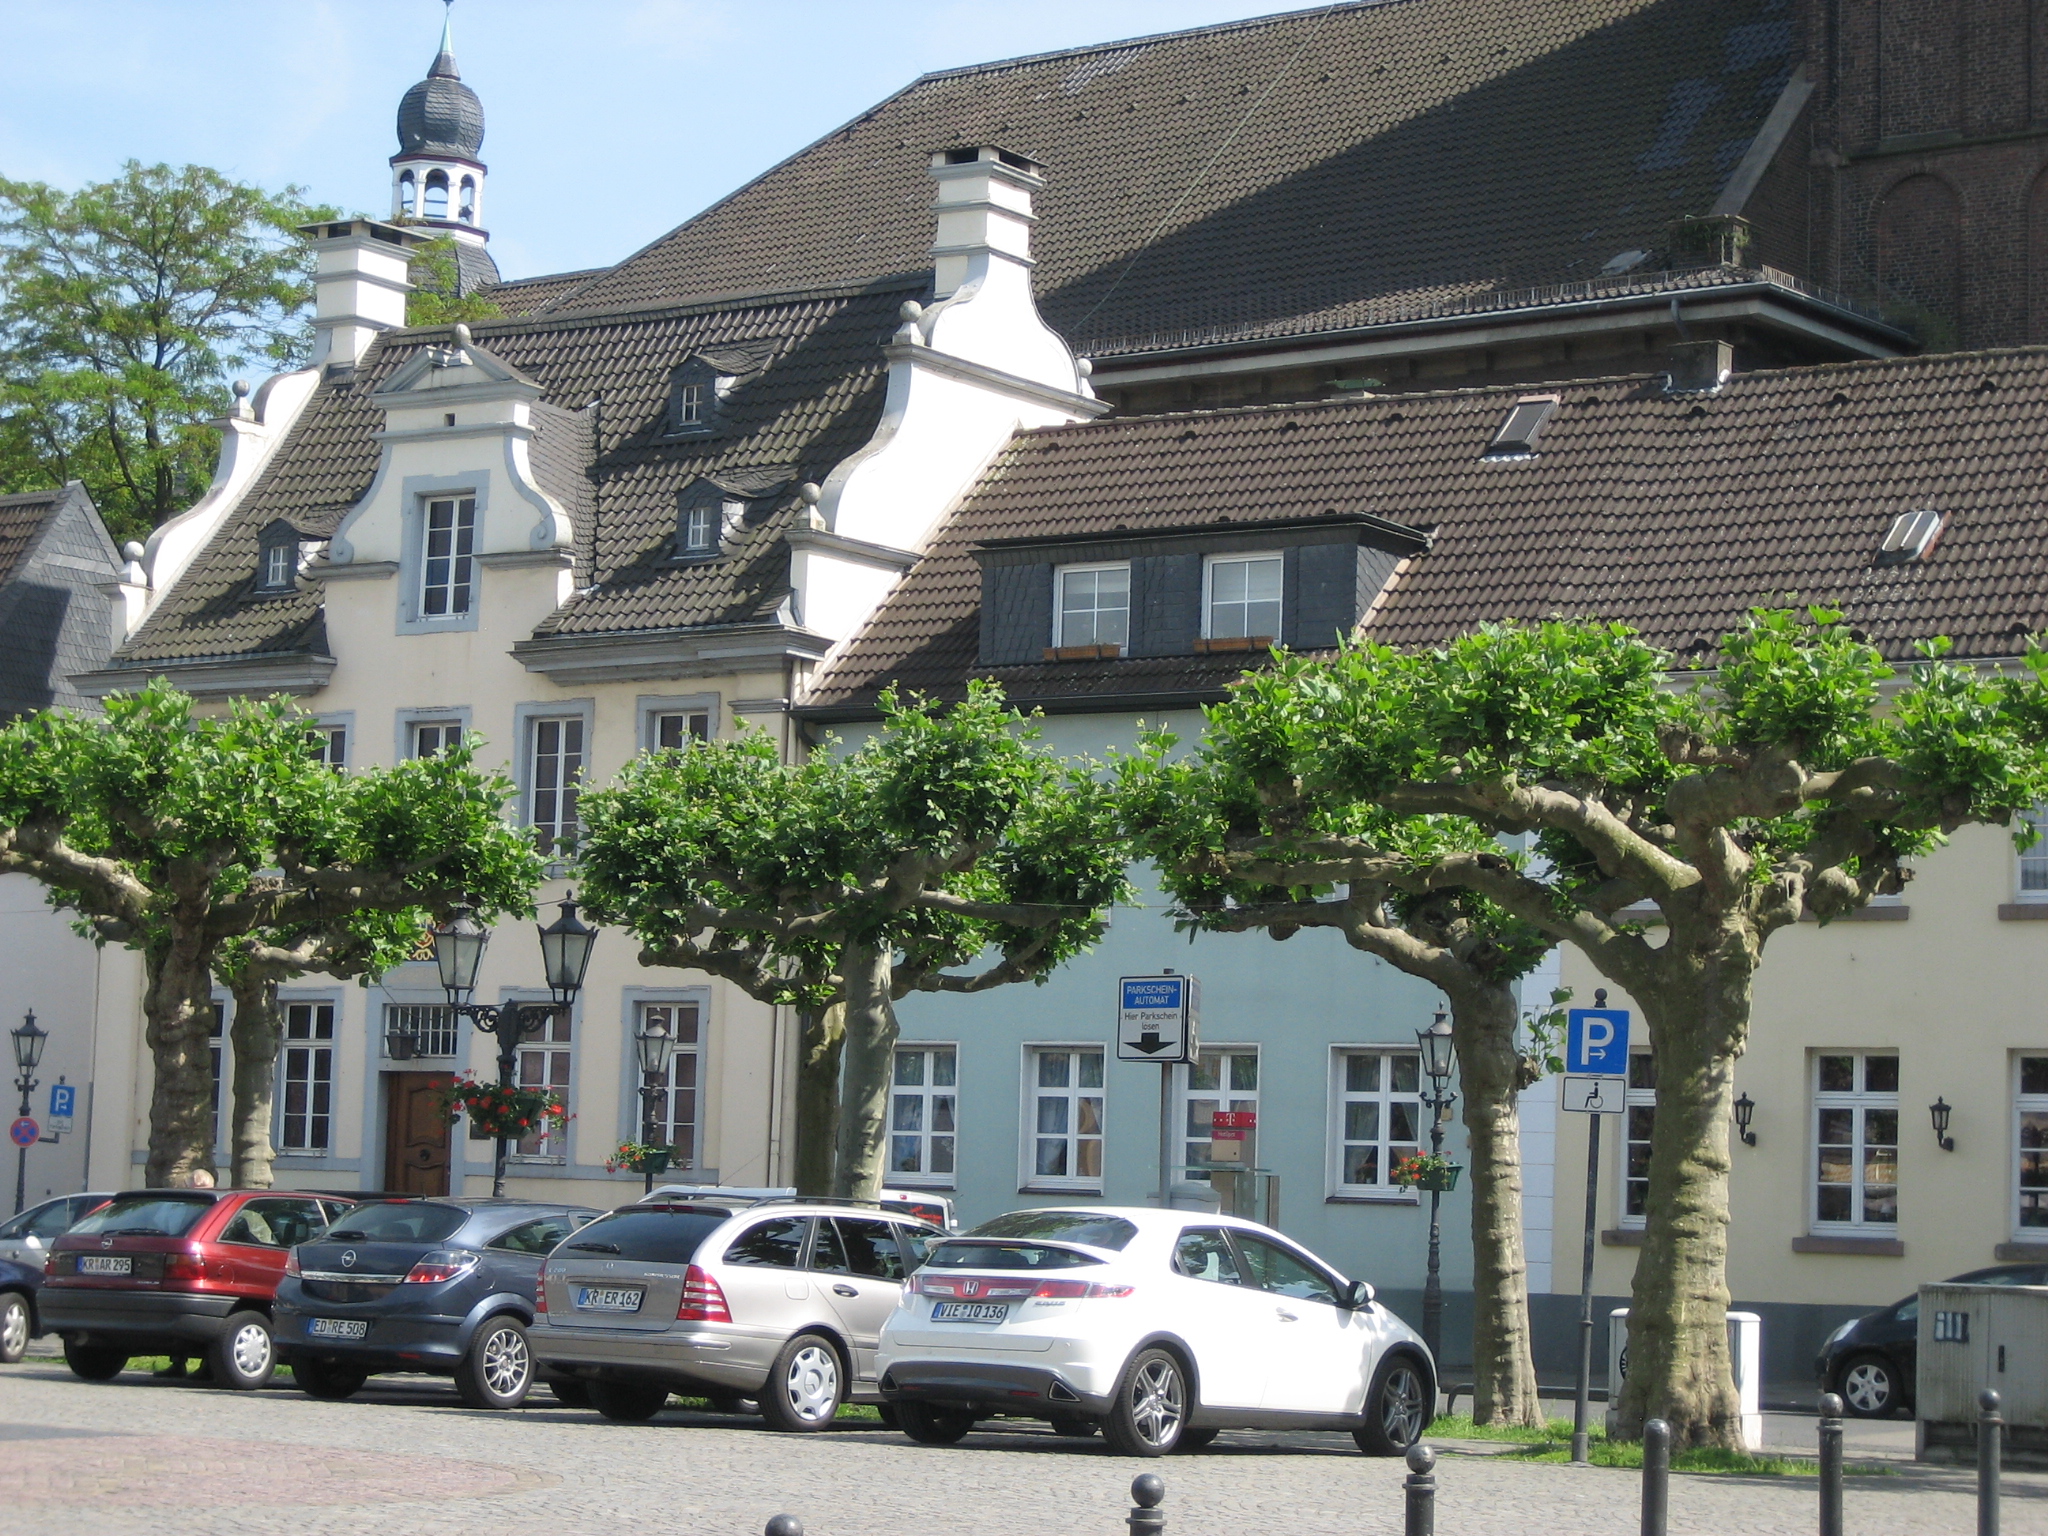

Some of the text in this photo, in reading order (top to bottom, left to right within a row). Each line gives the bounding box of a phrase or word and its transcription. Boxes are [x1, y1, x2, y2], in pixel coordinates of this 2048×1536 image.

[1126, 984, 1178, 995] PARKSCHEIN-
[1134, 995, 1170, 1005] AUTOMAT
[1124, 1011, 1178, 1020] Hier Parkschein
[1580, 1016, 1615, 1066] P
[55, 1088, 70, 1112] P
[100, 1259, 112, 1271] AR
[113, 1259, 131, 1272] 295
[604, 1291, 619, 1305] ER
[620, 1291, 640, 1306] 162
[940, 1304, 1004, 1319] VIE IQ 136
[313, 1320, 366, 1335] ED RE 508
